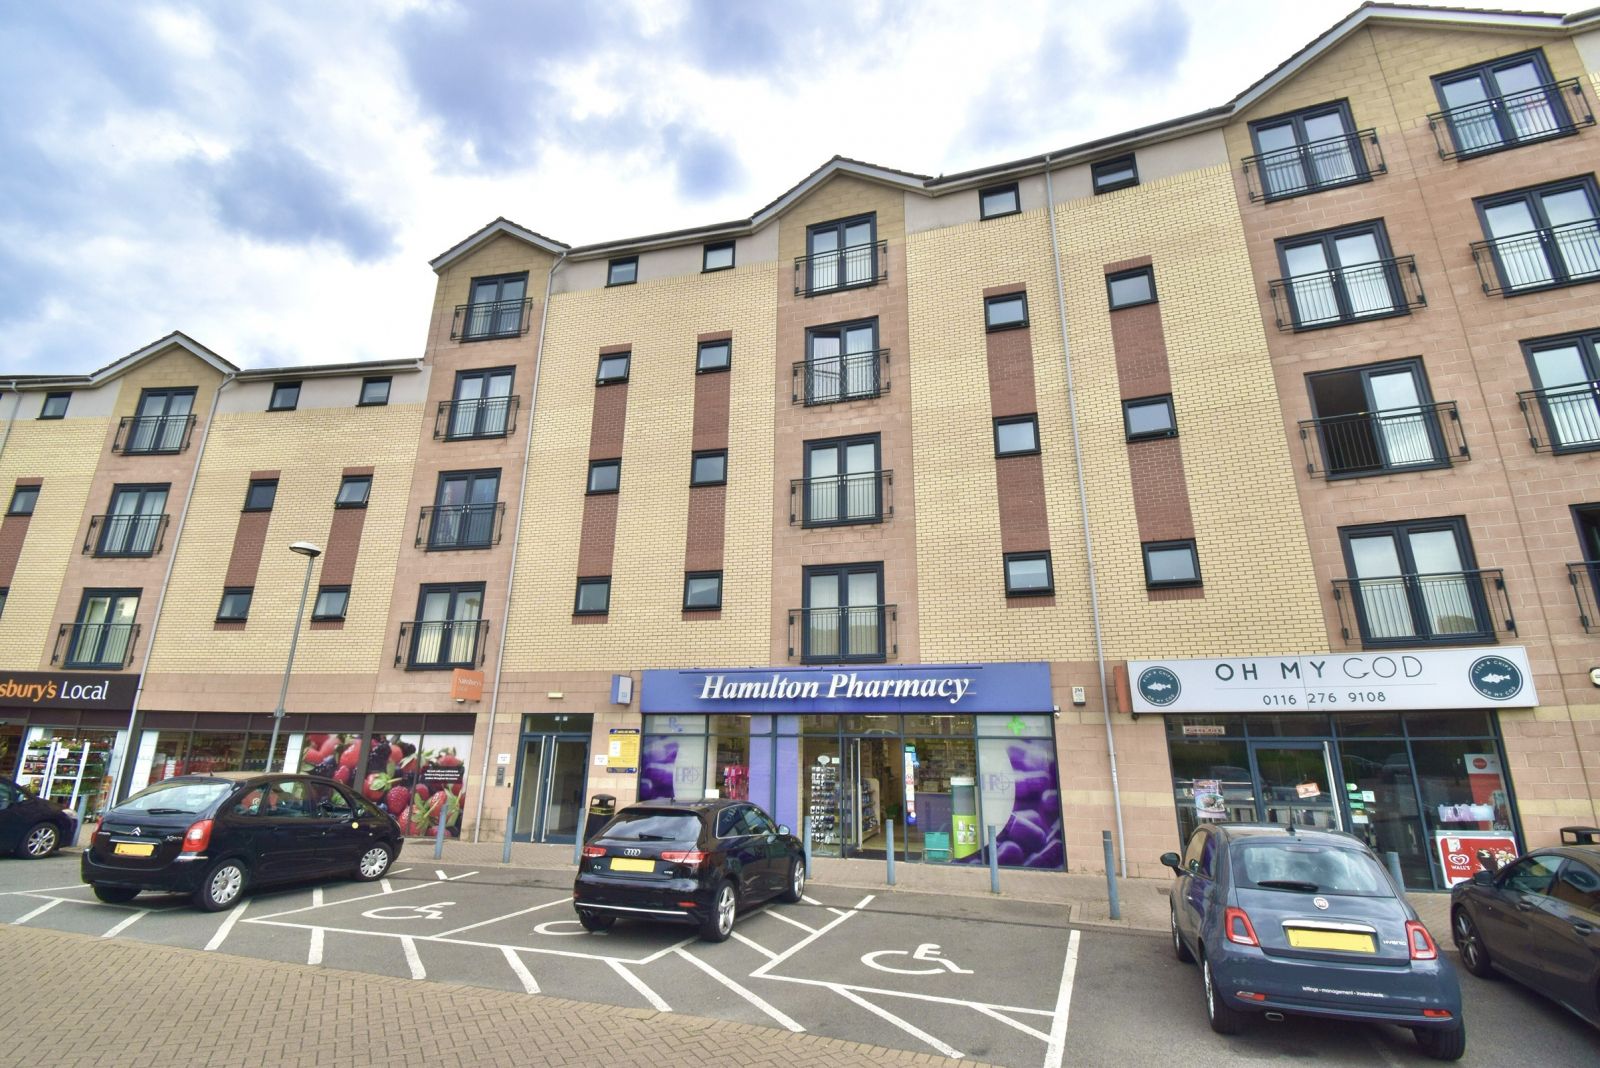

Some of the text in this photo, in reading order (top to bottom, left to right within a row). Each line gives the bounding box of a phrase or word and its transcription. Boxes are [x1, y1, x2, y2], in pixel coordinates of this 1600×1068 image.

[1215, 663, 1258, 681] OH
[1280, 660, 1326, 680] MY
[60, 680, 109, 700] Local
[699, 672, 970, 704] Hamilton Pharmacy
[1262, 691, 1386, 706] 0116 276 9108
